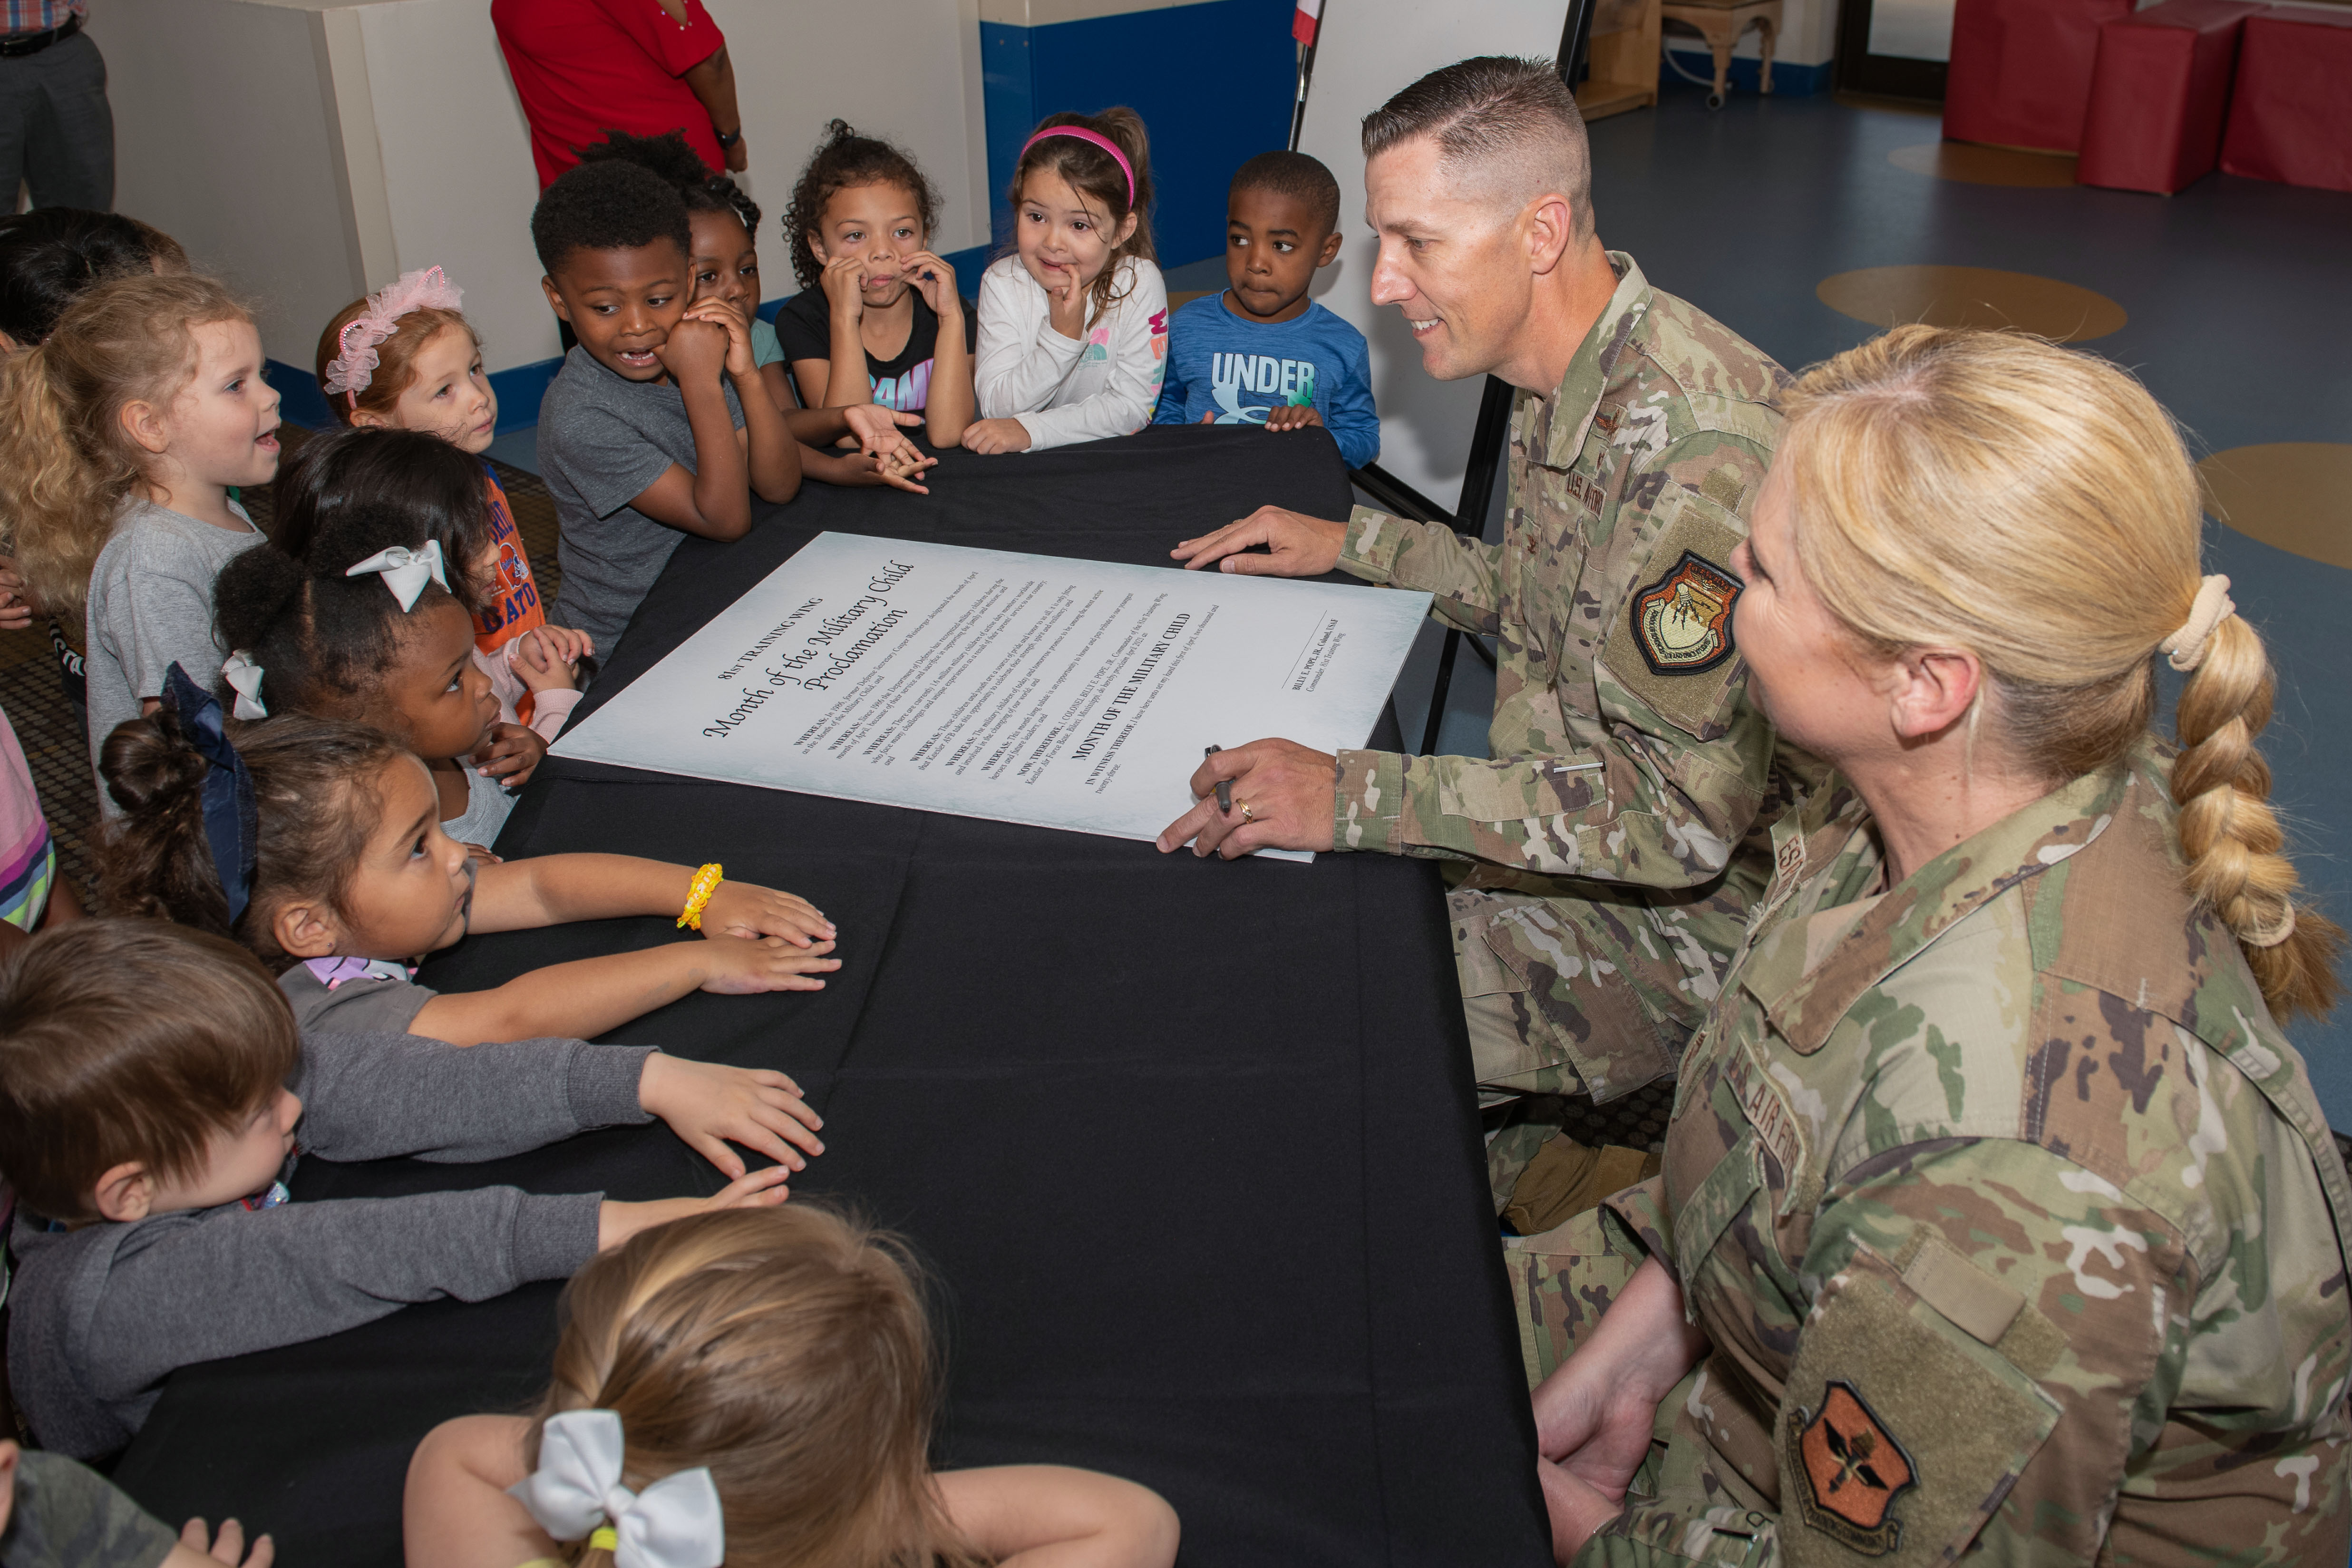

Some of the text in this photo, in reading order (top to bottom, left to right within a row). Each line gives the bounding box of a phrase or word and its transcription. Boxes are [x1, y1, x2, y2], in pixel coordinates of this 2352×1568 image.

[869, 358, 934, 412] AM
[1212, 352, 1315, 399] UNDER
[702, 559, 914, 738] Month of the Military Child
[736, 620, 796, 662] TRAINING
[787, 597, 823, 619] WING
[803, 609, 908, 691] Proclamation
[1292, 675, 1307, 691] BILLY
[1304, 656, 1319, 670] POPE,
[1317, 631, 1333, 646] Colonel,
[1326, 618, 1339, 630] USAF
[1071, 614, 1190, 761] MONTH OF THE MILITARY CHILD
[793, 718, 829, 745] WHEREAS:
[814, 726, 834, 740] Month
[827, 722, 863, 750] WHEREAS:
[862, 726, 896, 755] WHEREAS:
[871, 754, 884, 764] who
[879, 743, 894, 755] face
[890, 731, 906, 744] many
[910, 732, 943, 761] WHEREAS:
[1017, 761, 1037, 776] NOW,
[1029, 725, 1065, 760] THEREFORE,
[1090, 751, 1116, 777] WITNESS
[1109, 723, 1137, 750] THEREOF,
[836, 745, 854, 760] month
[884, 756, 895, 766] and
[918, 760, 931, 770] that
[925, 743, 946, 761] Keesler
[943, 732, 956, 744] AFB
[945, 737, 977, 766] WHEREAS:
[955, 765, 966, 775] and
[961, 746, 983, 766] involved
[981, 741, 1012, 770] WHEREAS:
[988, 764, 1008, 780] heroes
[1004, 753, 1015, 764] and
[1010, 740, 1026, 756] future
[1025, 767, 1044, 785] Keesler
[1040, 758, 1050, 767] Air
[1045, 745, 1062, 759] Force
[1095, 764, 1121, 794] twenty-three.
[1748, 1083, 1780, 1138] AIR
